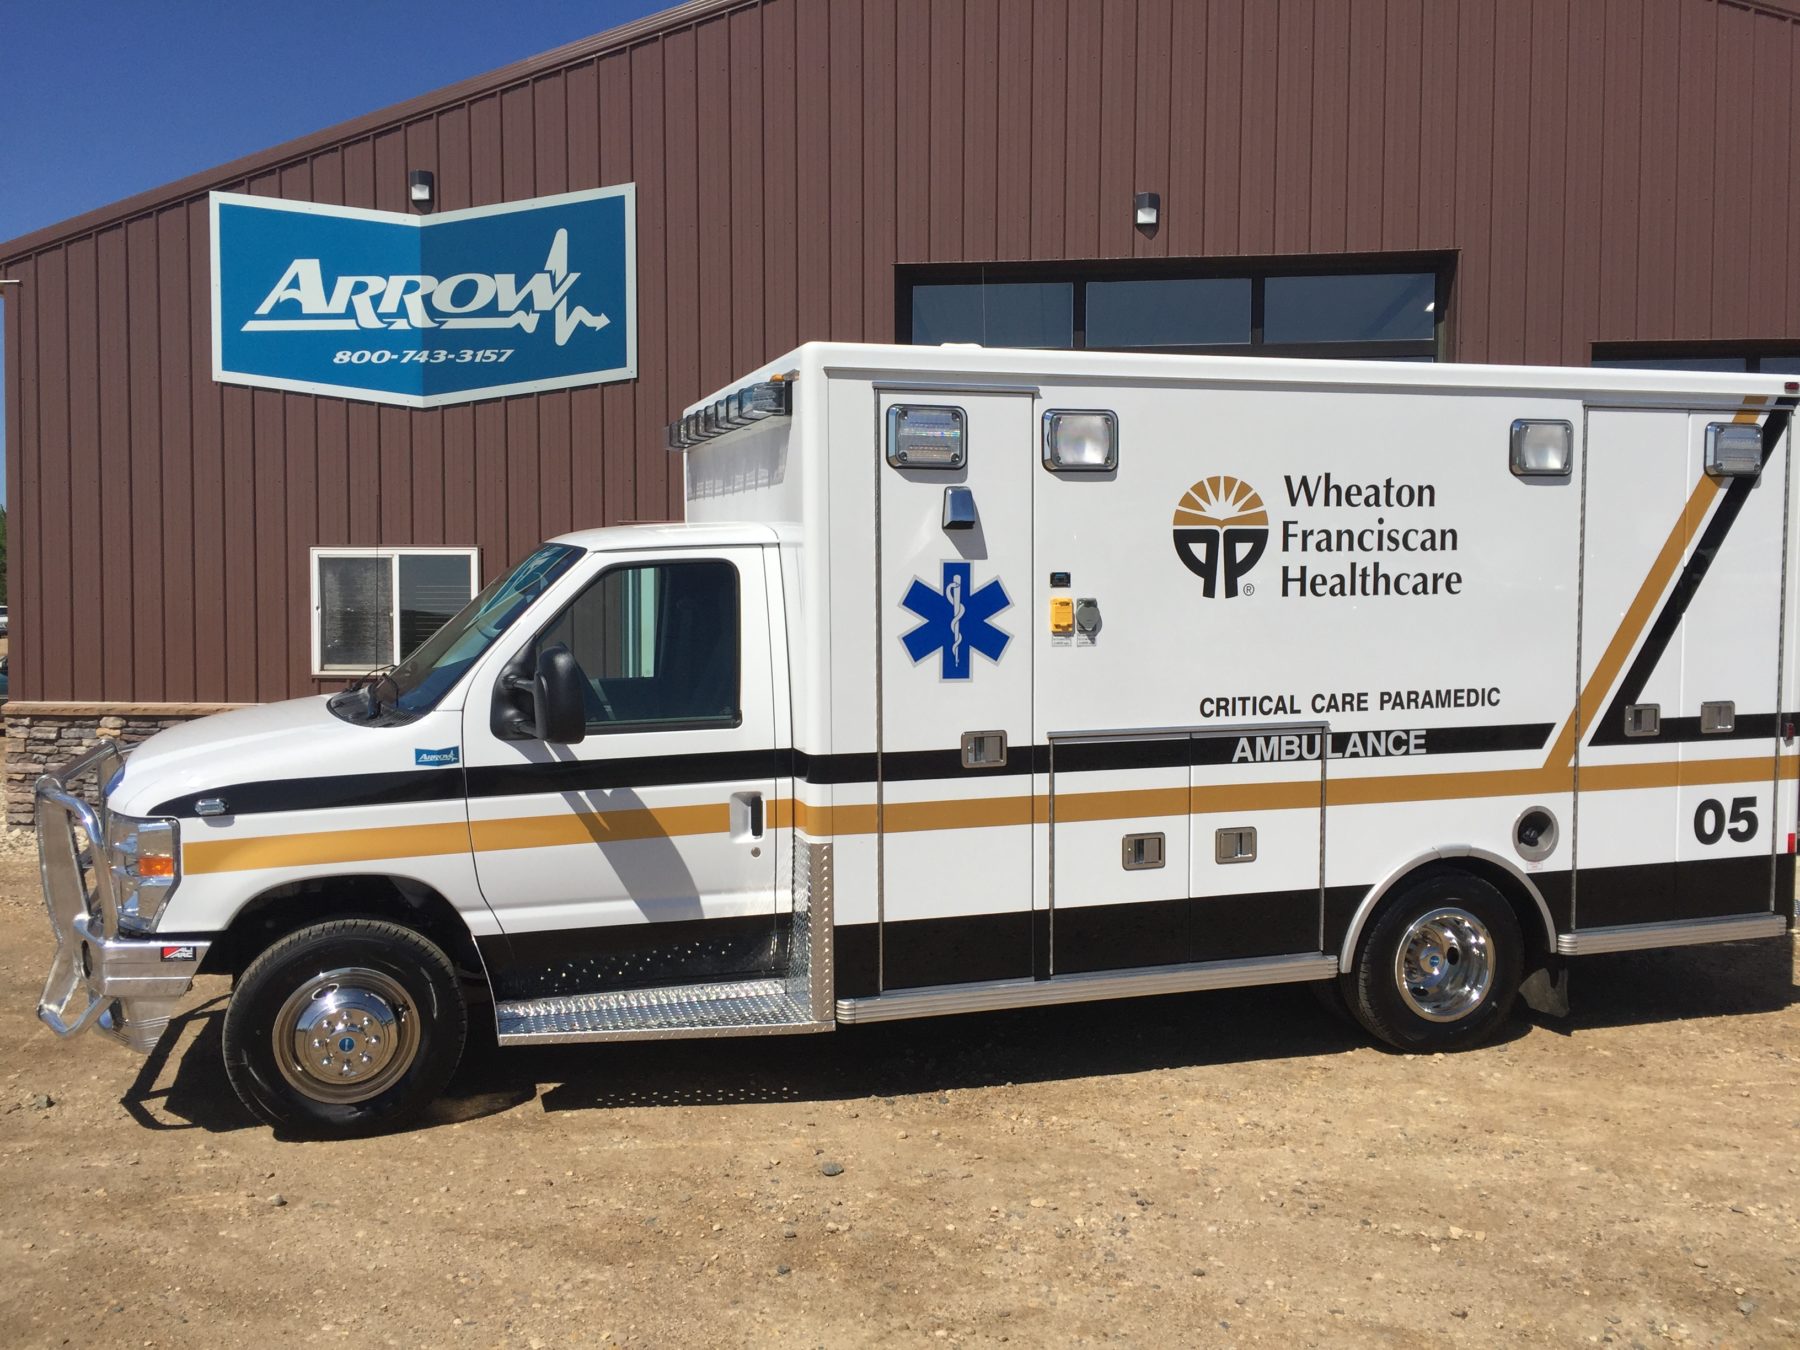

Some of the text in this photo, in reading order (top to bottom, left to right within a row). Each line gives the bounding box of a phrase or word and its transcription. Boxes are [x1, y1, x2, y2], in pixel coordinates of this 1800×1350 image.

[332, 348, 515, 365] 800-743-3157
[1283, 472, 1436, 508] Wheaton
[1281, 517, 1459, 553] Franciscan
[1281, 561, 1463, 598] Healthcare
[1199, 687, 1501, 719] CRITICAL CARE PARAMEDIC
[1231, 729, 1428, 763] AMBULANCE
[1693, 796, 1759, 846] 05
